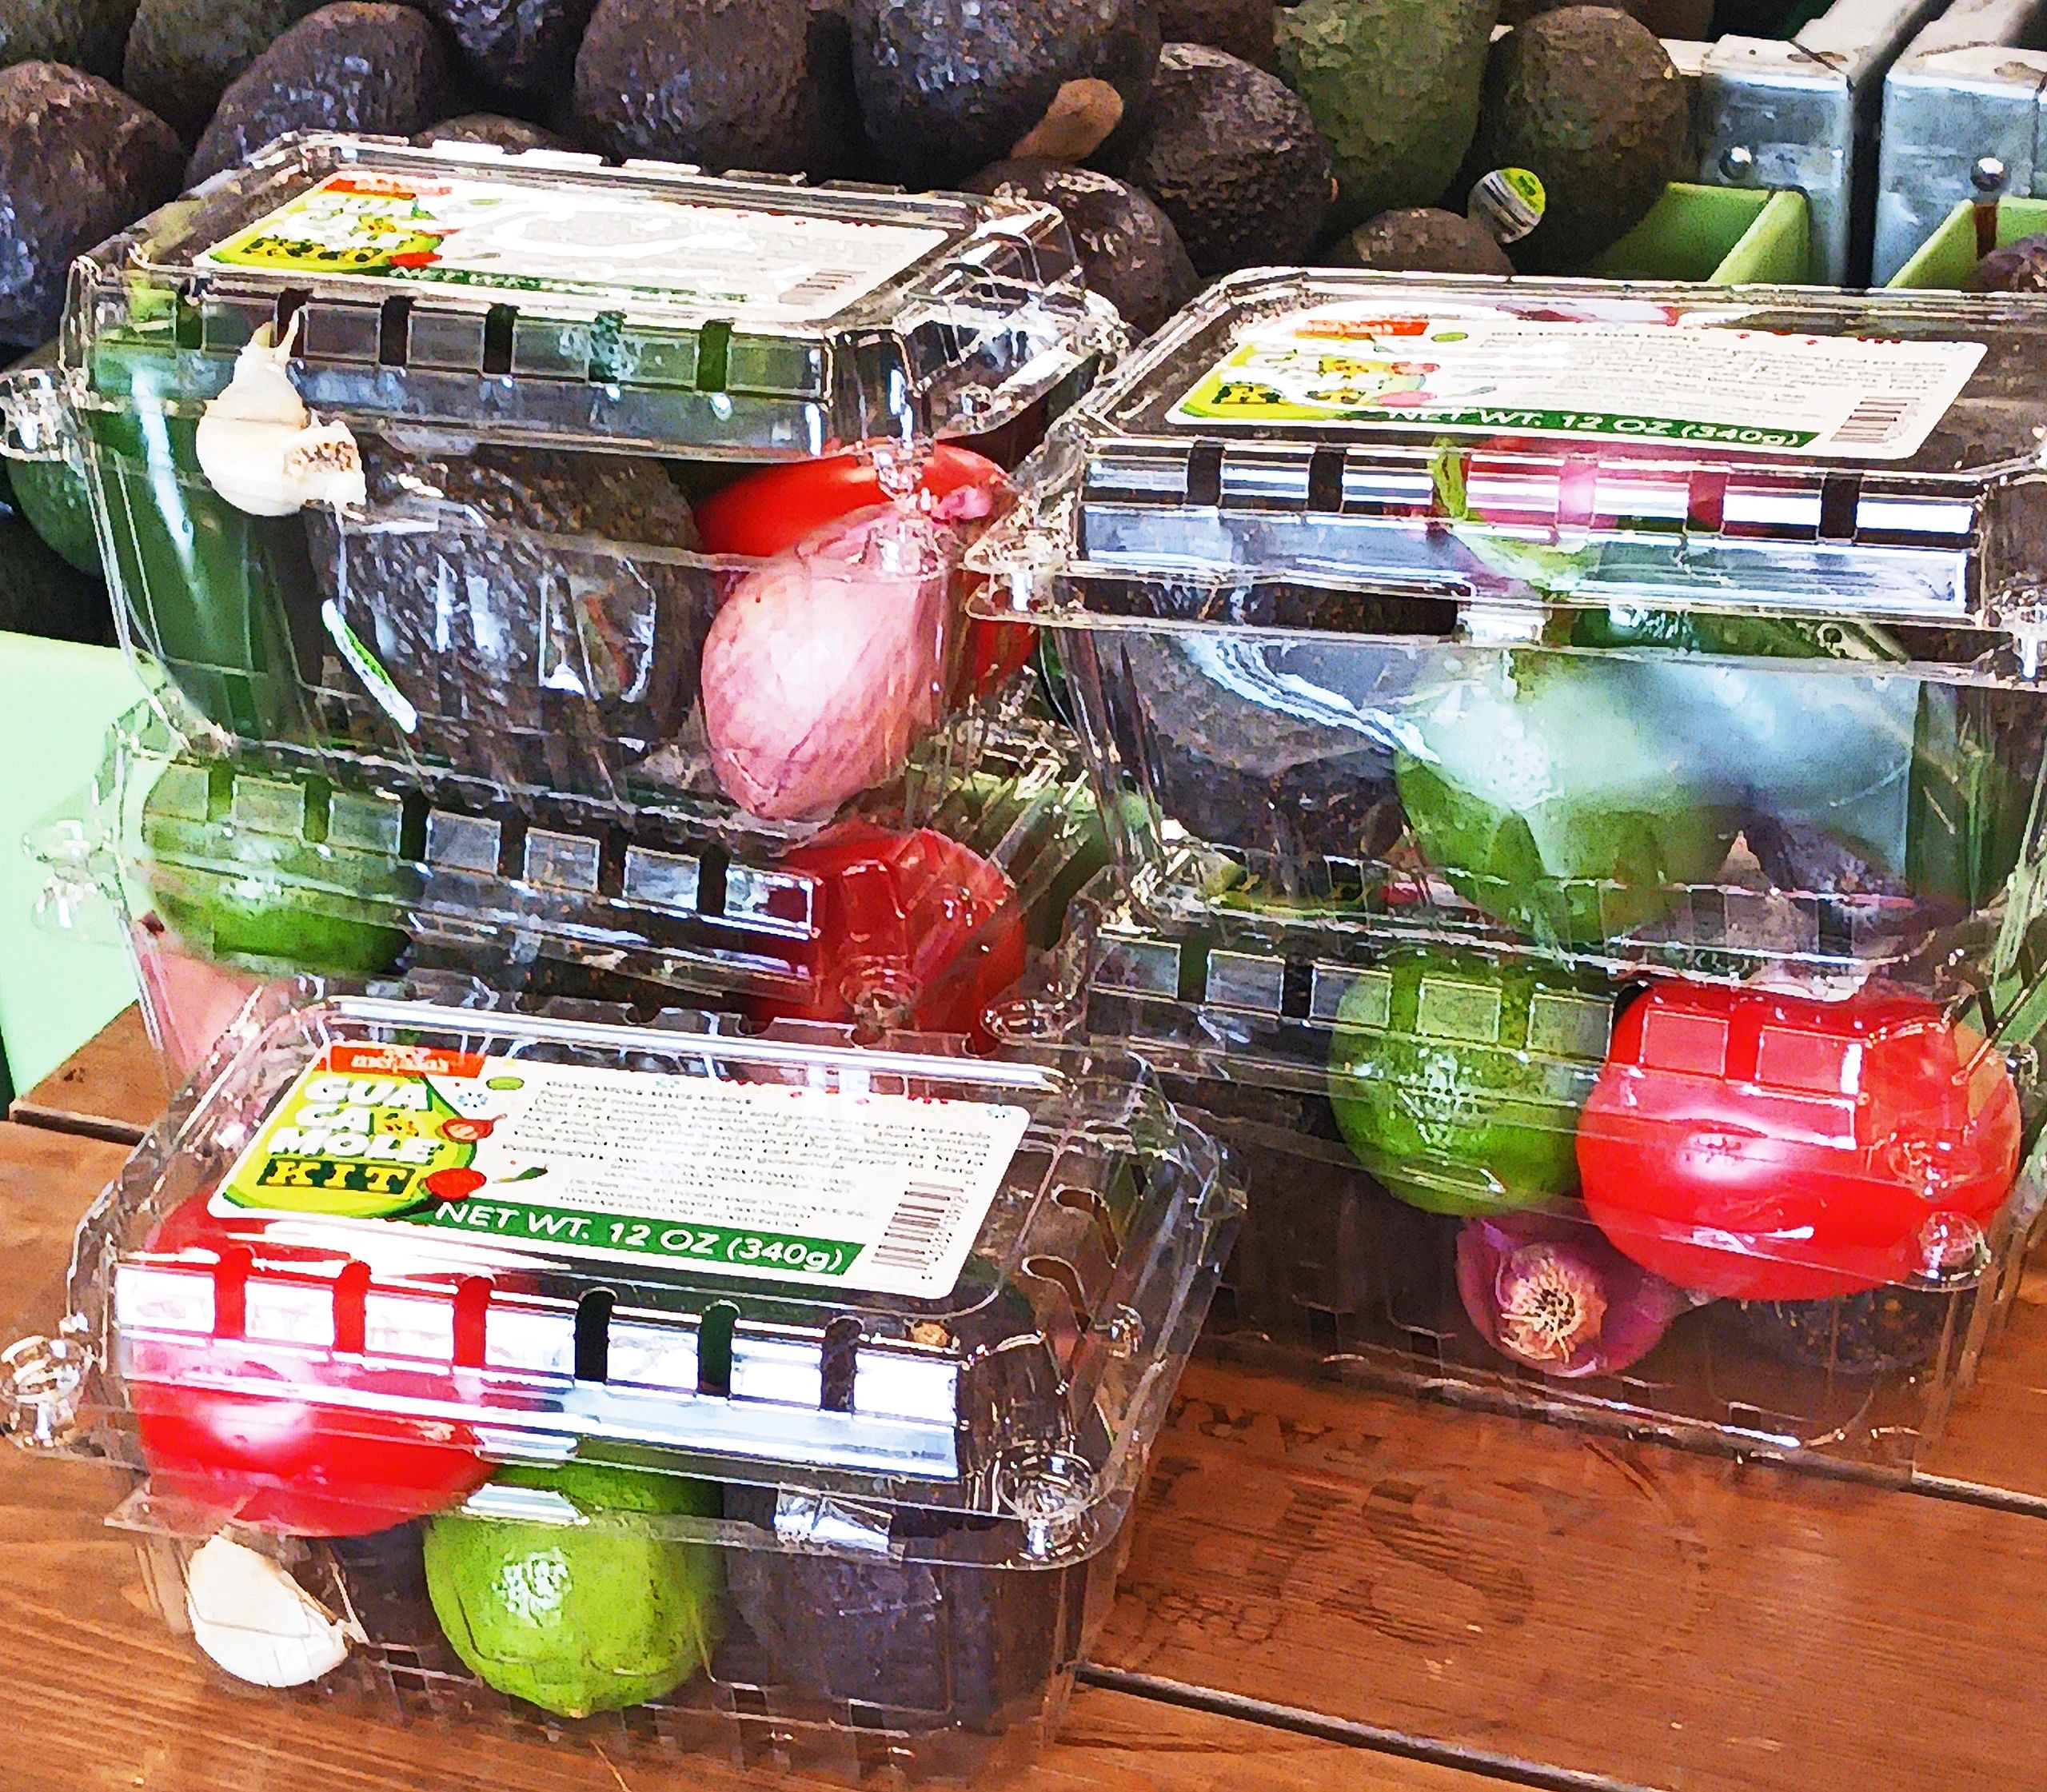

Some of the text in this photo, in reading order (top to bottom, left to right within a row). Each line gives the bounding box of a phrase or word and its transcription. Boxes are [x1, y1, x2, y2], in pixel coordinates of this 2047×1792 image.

[1480, 409, 1543, 427] WT.
[1562, 414, 1603, 429] 12
[1613, 418, 1673, 435] OZ
[266, 1126, 443, 1165] MOLE
[265, 1160, 409, 1192] KIT
[435, 1201, 843, 1273] NET WT. 12 OZ (340g)
